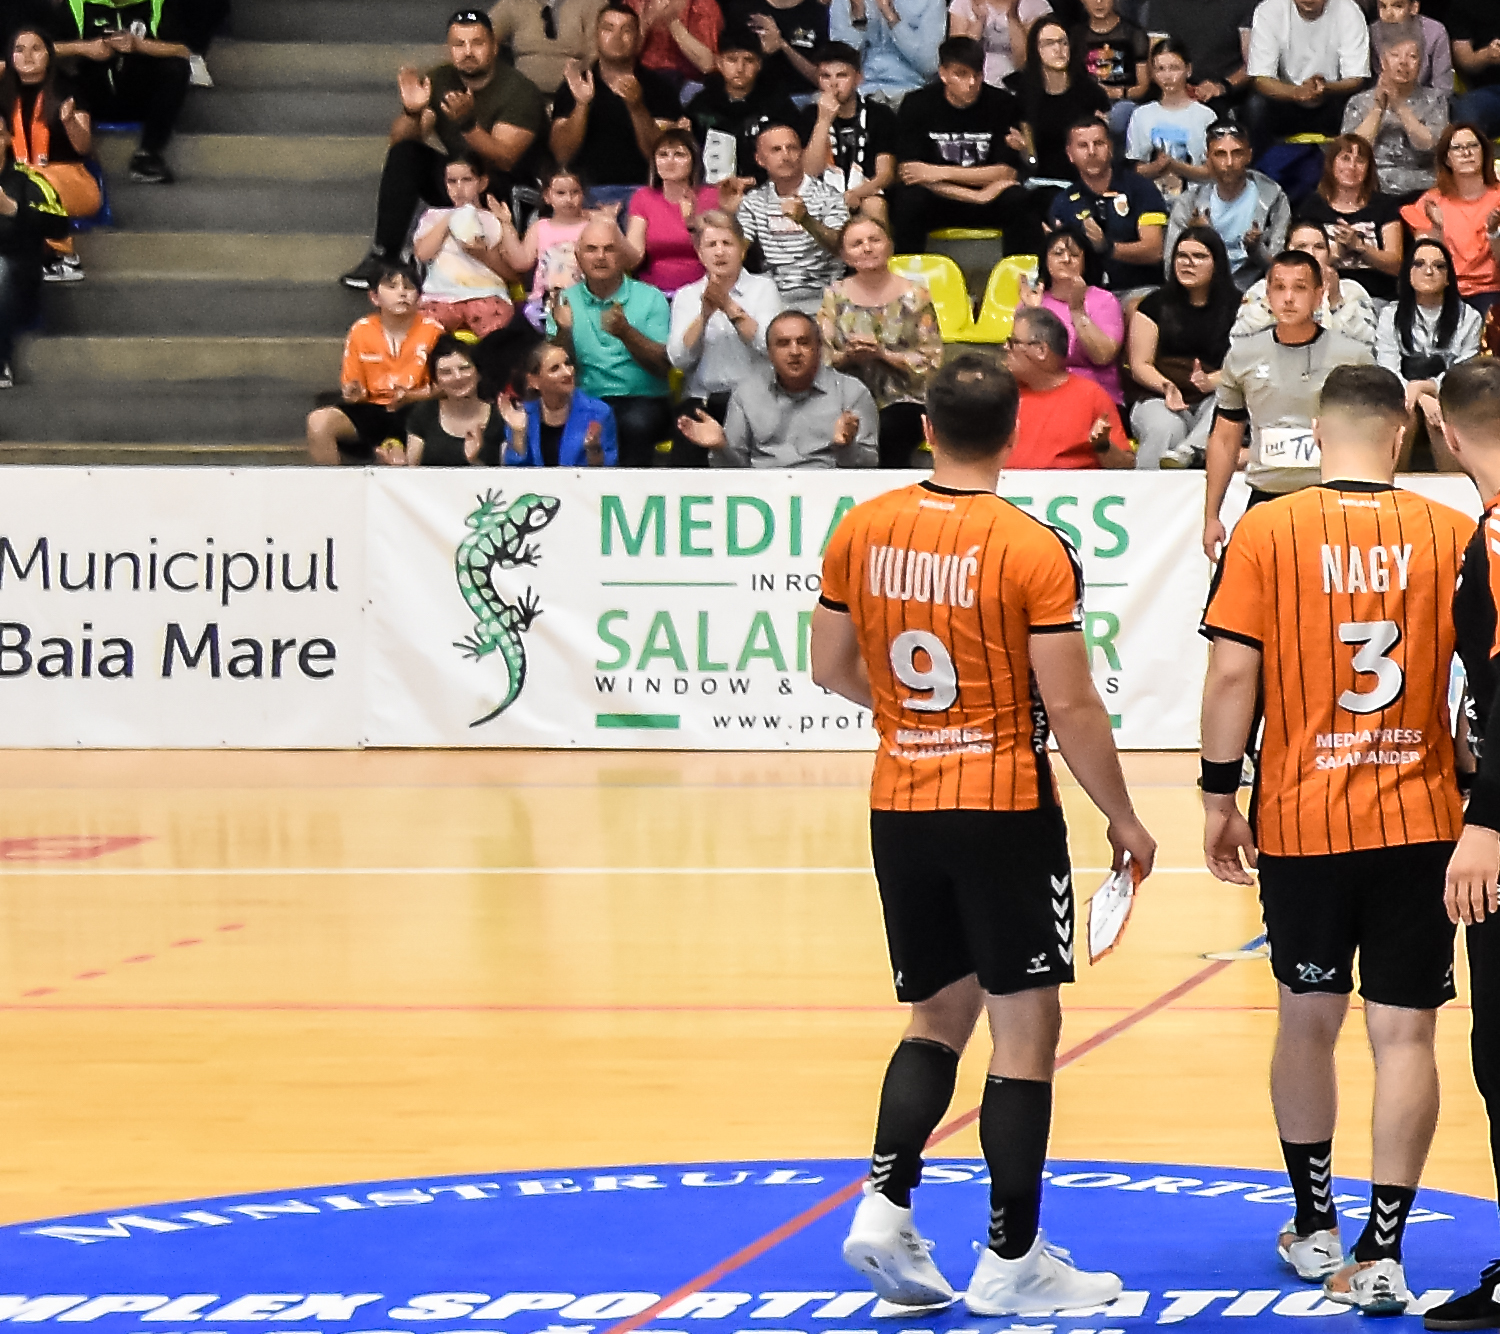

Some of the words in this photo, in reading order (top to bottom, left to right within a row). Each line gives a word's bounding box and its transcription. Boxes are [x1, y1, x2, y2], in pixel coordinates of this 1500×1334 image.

[0, 537, 339, 607] Municipiul
[752, 573, 776, 592] IN
[868, 544, 981, 610] VUJOVIĆ
[1320, 543, 1414, 595] NAGY
[0, 622, 134, 679] Baia
[162, 622, 337, 679] Mare
[890, 629, 958, 713] 9
[1337, 619, 1404, 715] 3
[595, 675, 751, 695] WINDOW
[777, 677, 794, 695] &
[1315, 729, 1423, 748] MEDIAPRESS
[22, 1166, 826, 1245] MINISTERUL
